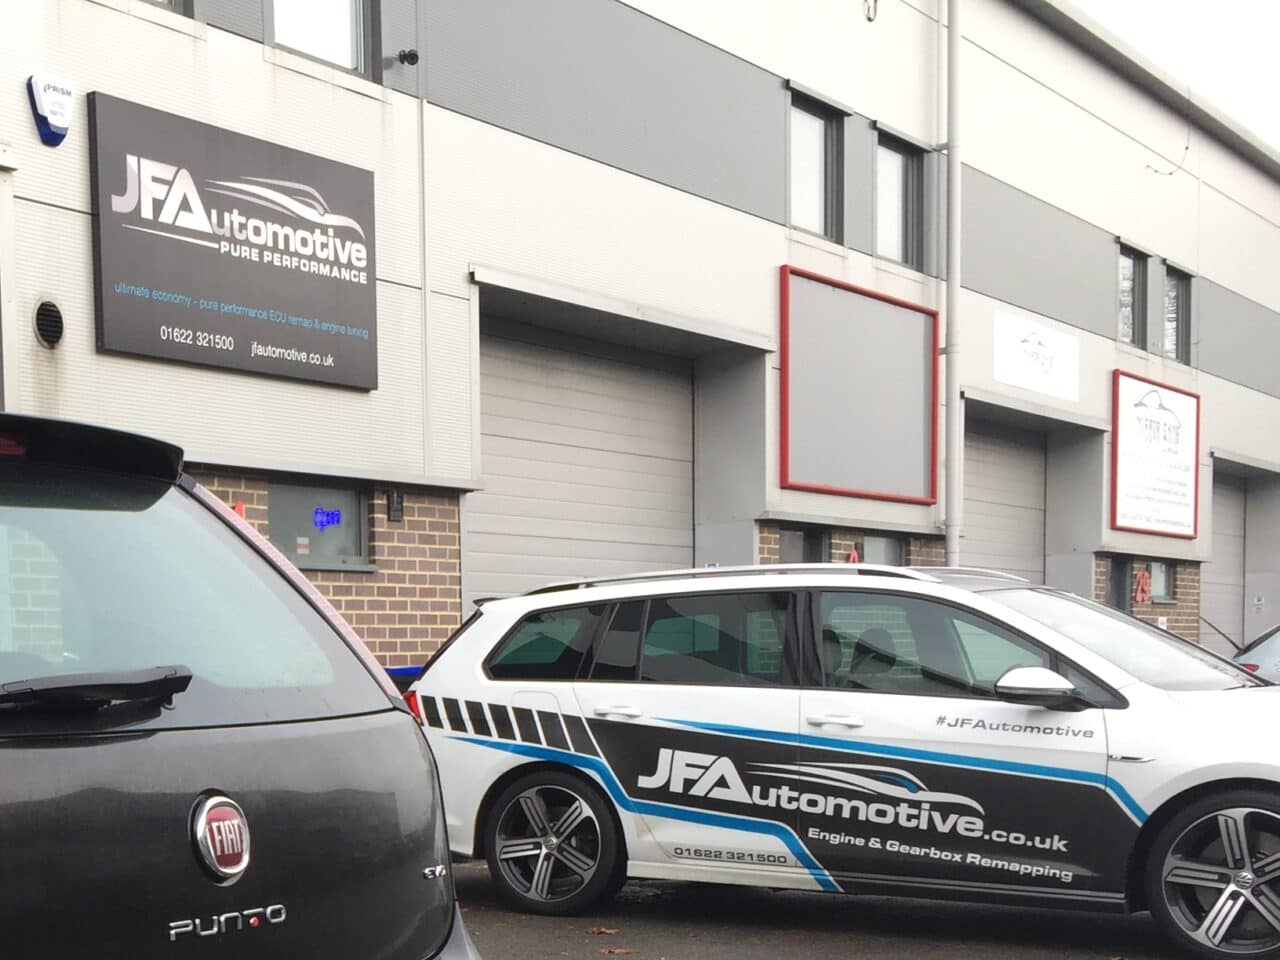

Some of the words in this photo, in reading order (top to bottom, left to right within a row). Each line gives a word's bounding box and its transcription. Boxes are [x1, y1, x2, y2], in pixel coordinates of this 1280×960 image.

[220, 241, 260, 262] PURE
[263, 250, 368, 285] PERFORMANCE
[151, 289, 191, 309] economy
[199, 298, 219, 312] pure
[220, 302, 268, 322] performance
[269, 309, 287, 322] ECU
[160, 325, 193, 345] 01622
[196, 331, 234, 351] 321500
[251, 341, 335, 368] jfautomotive.co.uk
[936, 714, 1095, 739] #JFAutomotive
[211, 819, 243, 856] FIAT
[673, 847, 723, 859] 01622
[726, 851, 788, 864] 321500
[808, 827, 865, 847] Engine
[868, 838, 882, 849] &
[886, 840, 962, 863] Gearbox
[966, 853, 1073, 882] Remapping
